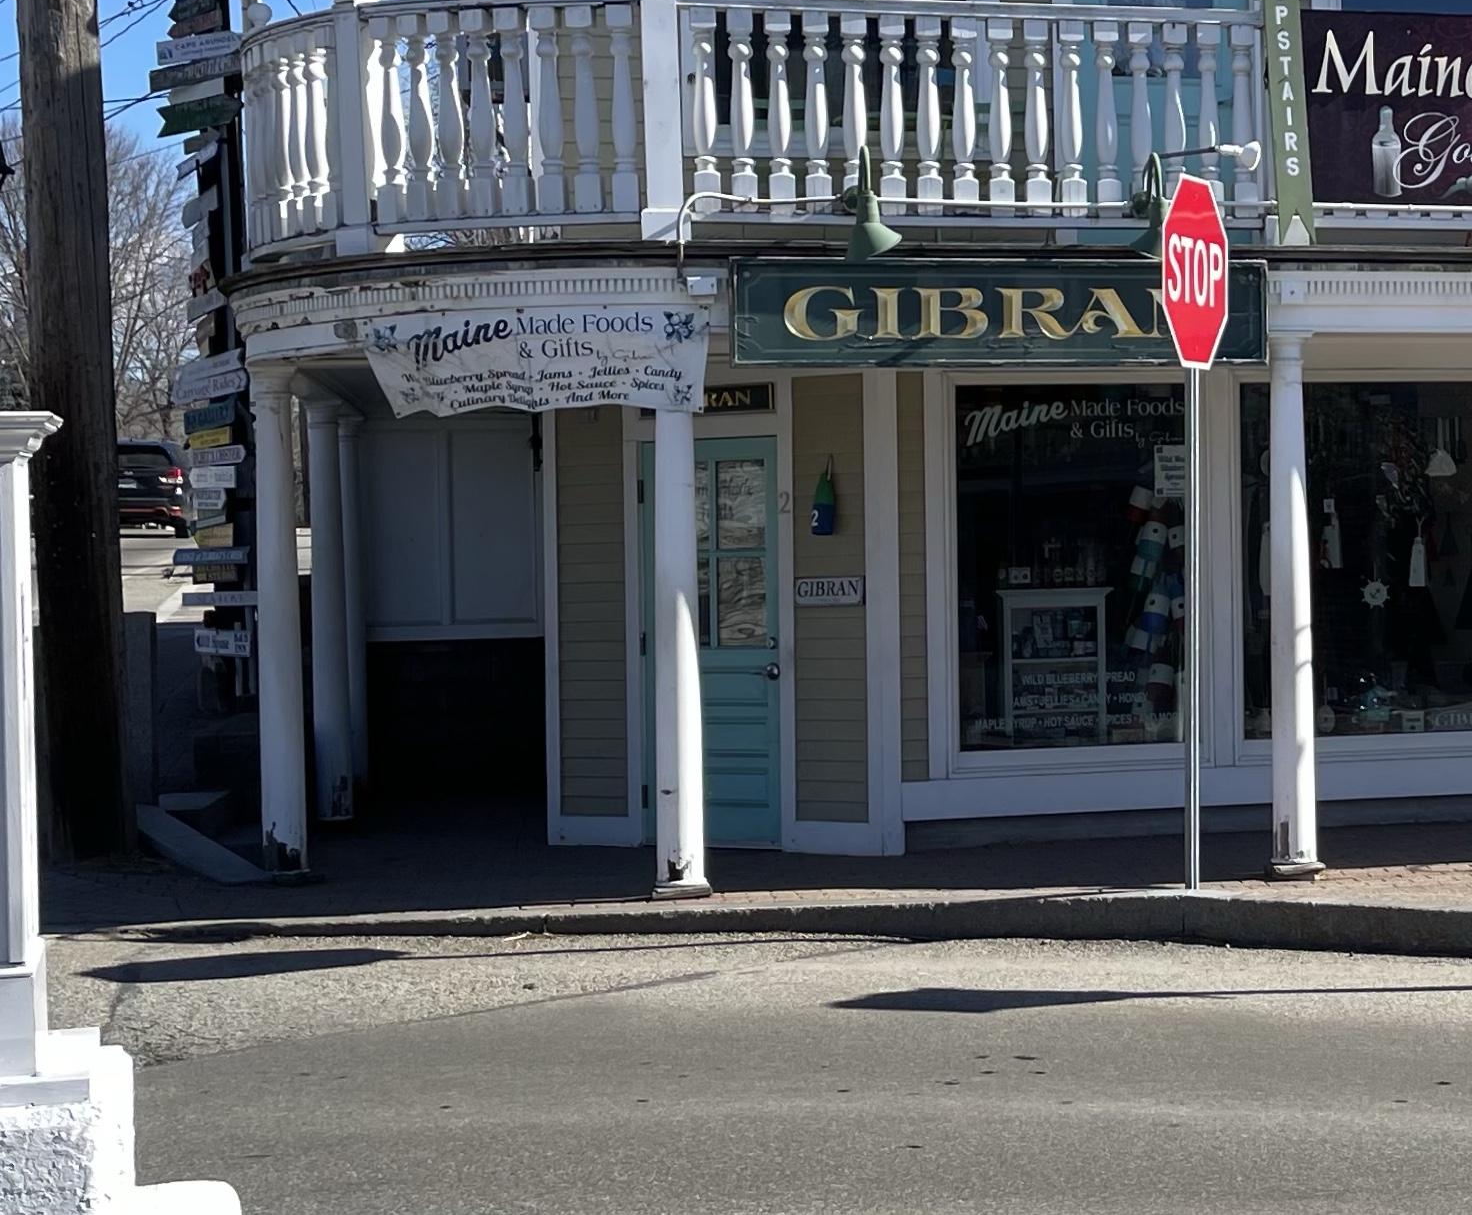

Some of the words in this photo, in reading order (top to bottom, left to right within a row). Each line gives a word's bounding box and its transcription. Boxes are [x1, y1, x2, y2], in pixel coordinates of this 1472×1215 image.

[1167, 232, 1223, 308] STOP
[407, 317, 516, 371] Maine
[516, 315, 575, 337] Made
[582, 312, 653, 334] Foods
[520, 341, 533, 359] &
[541, 339, 594, 358] Gifts
[488, 368, 526, 383] Spread
[537, 368, 573, 382] Jams
[589, 365, 631, 379] Jellies
[643, 365, 683, 382] Candy
[462, 381, 503, 394] Maple
[505, 382, 534, 396] Syrup
[548, 380, 572, 391] Hot
[576, 378, 617, 390] Sauce
[630, 378, 665, 392] Spices
[449, 393, 506, 410] Culinary
[565, 391, 596, 403] And
[597, 390, 630, 402] More
[964, 401, 1069, 447] Maine
[1070, 398, 1121, 417] Made
[1127, 398, 1184, 416] Foods
[1070, 422, 1084, 439] &
[1090, 419, 1134, 439] Gifts
[779, 491, 791, 513] 2
[811, 509, 819, 527] 2
[796, 579, 860, 598] GIBRAN
[1022, 672, 1044, 686] WILD
[1046, 671, 1099, 685] BLUEBERRY
[1101, 670, 1136, 683] PREAD
[1010, 693, 1034, 707] AMS
[1040, 693, 1075, 706] JELLIES
[1010, 717, 1038, 729] YRUP
[1044, 716, 1061, 728] HOT
[1063, 716, 1095, 727] SAUCE
[1102, 714, 1133, 726] PICES
